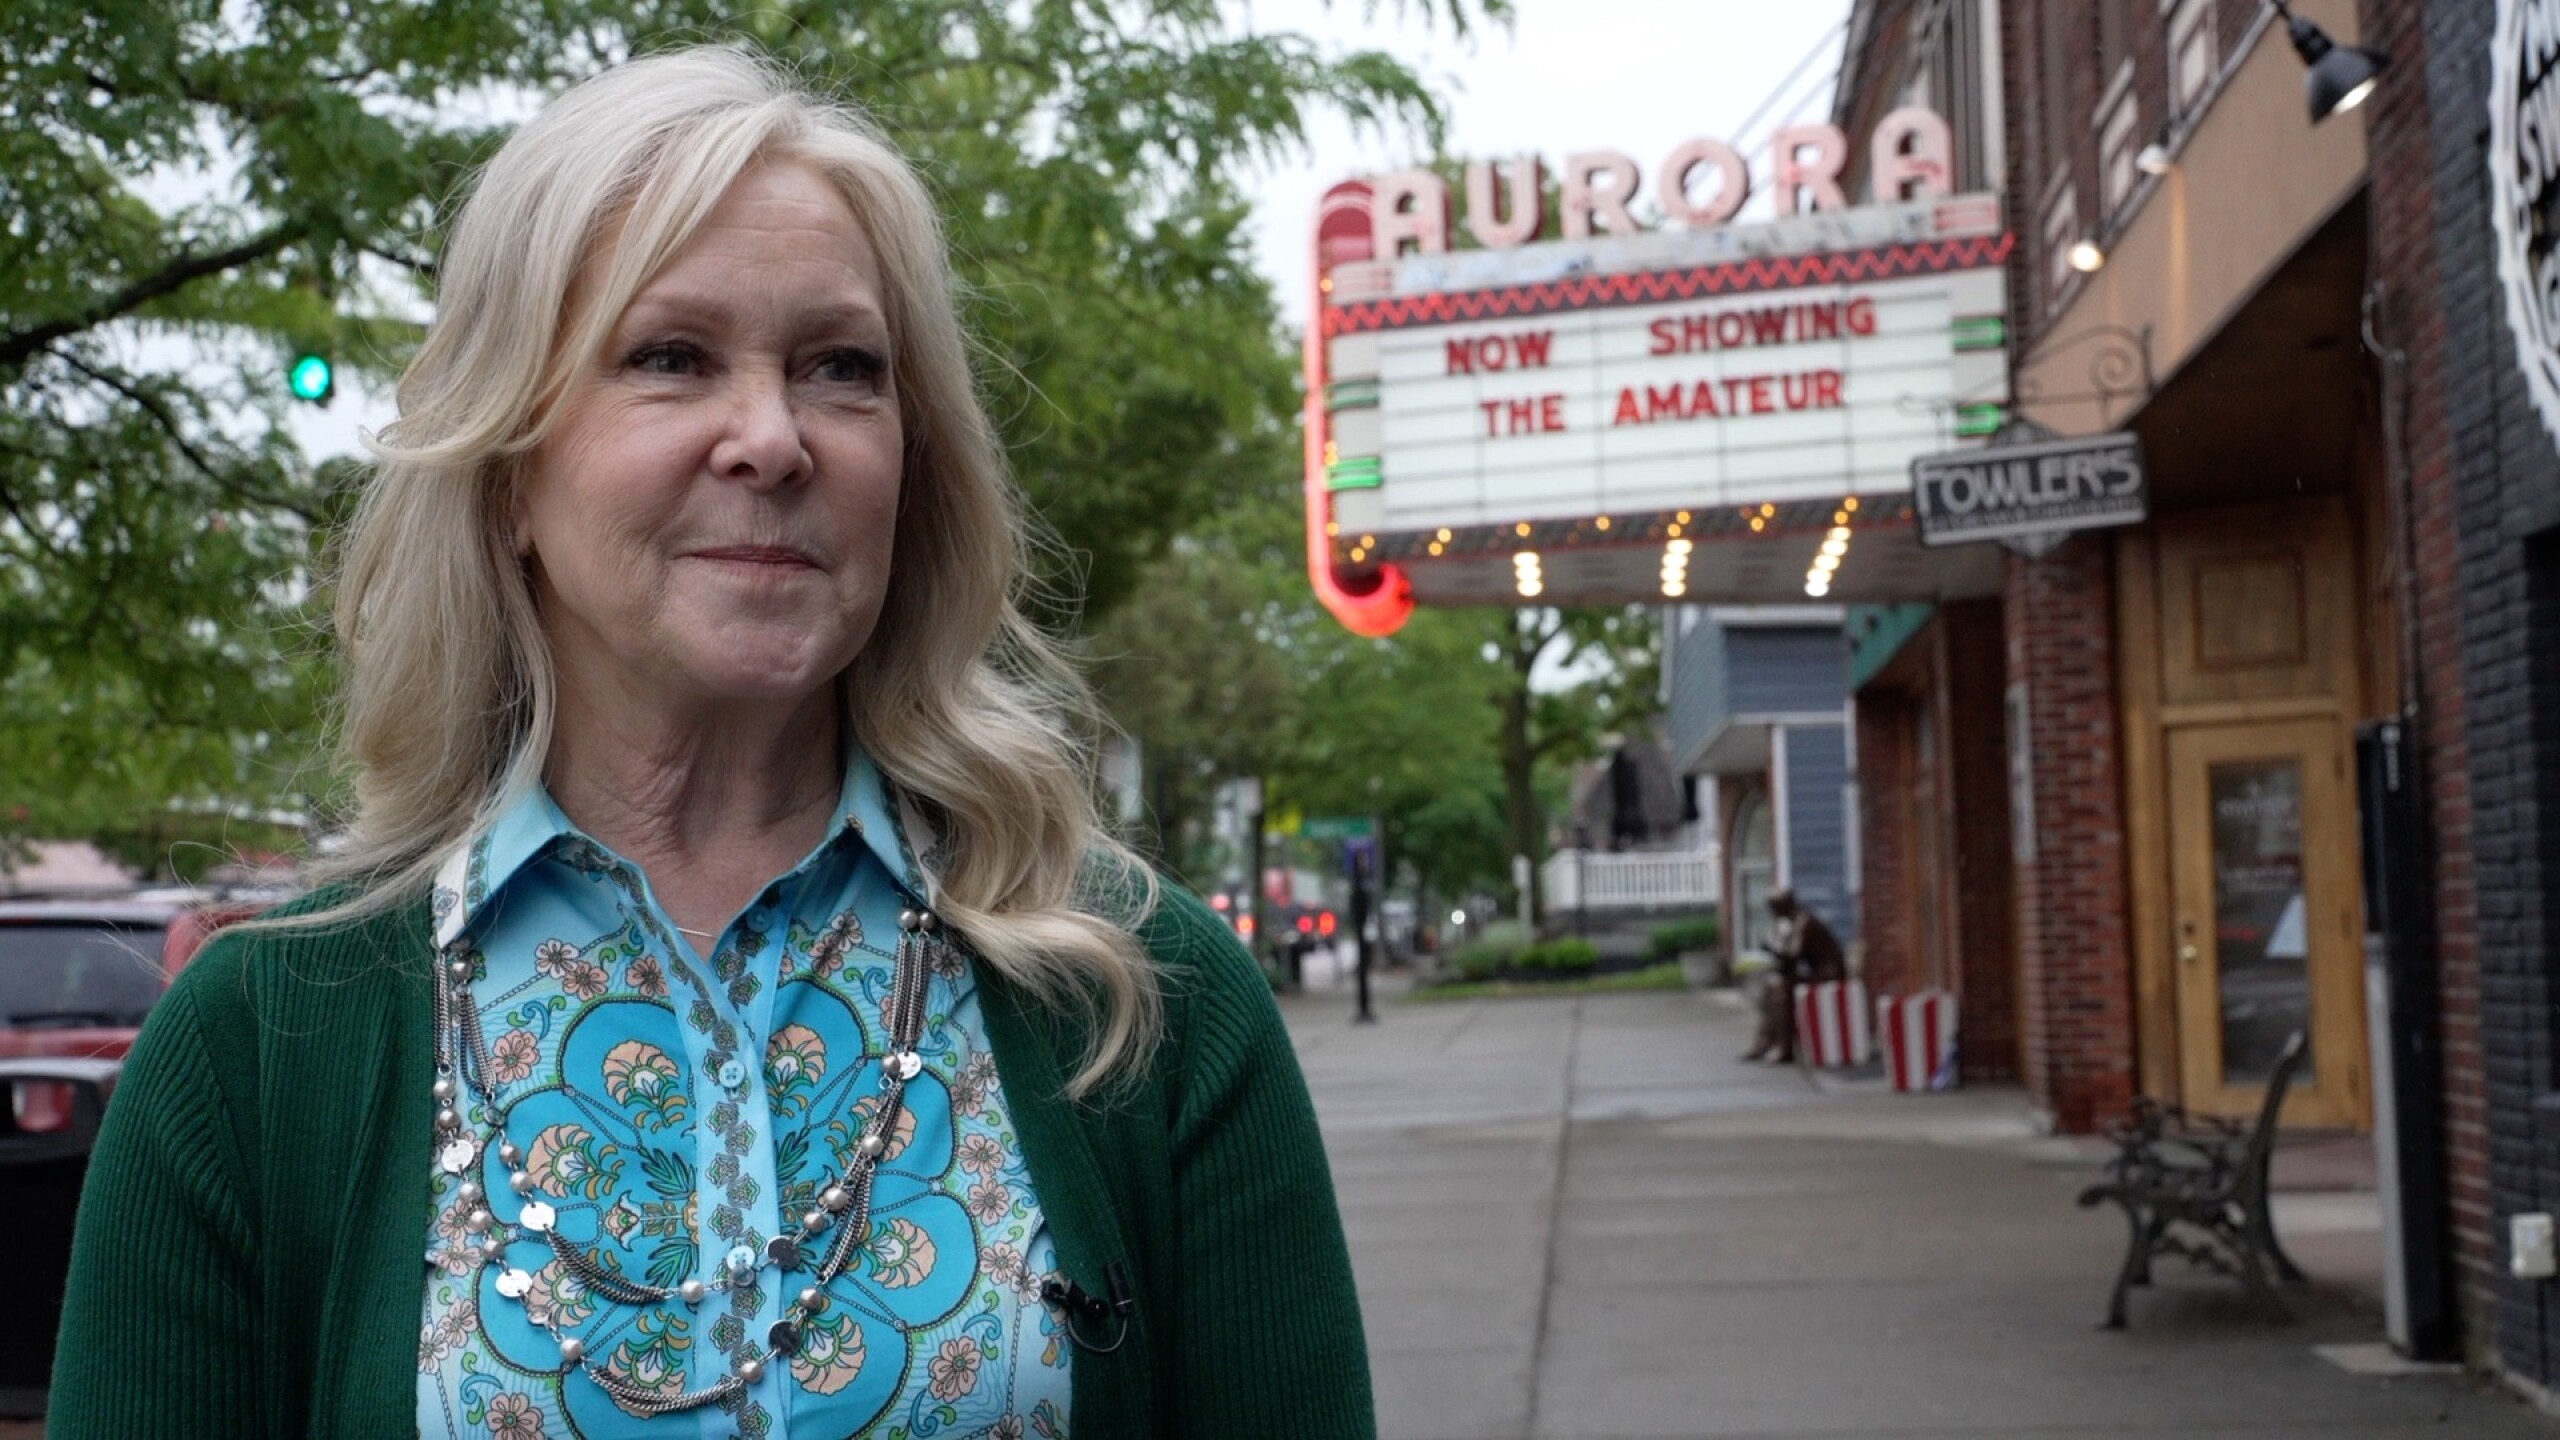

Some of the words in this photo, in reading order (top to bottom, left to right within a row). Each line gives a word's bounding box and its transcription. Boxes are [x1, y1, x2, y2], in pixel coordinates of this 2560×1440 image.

[1372, 106, 1955, 260] AURORA
[1446, 330, 1553, 374] NOW
[1649, 297, 1876, 356] SHOWING
[1480, 393, 1565, 438] THE
[1613, 369, 1844, 426] AMATEUR
